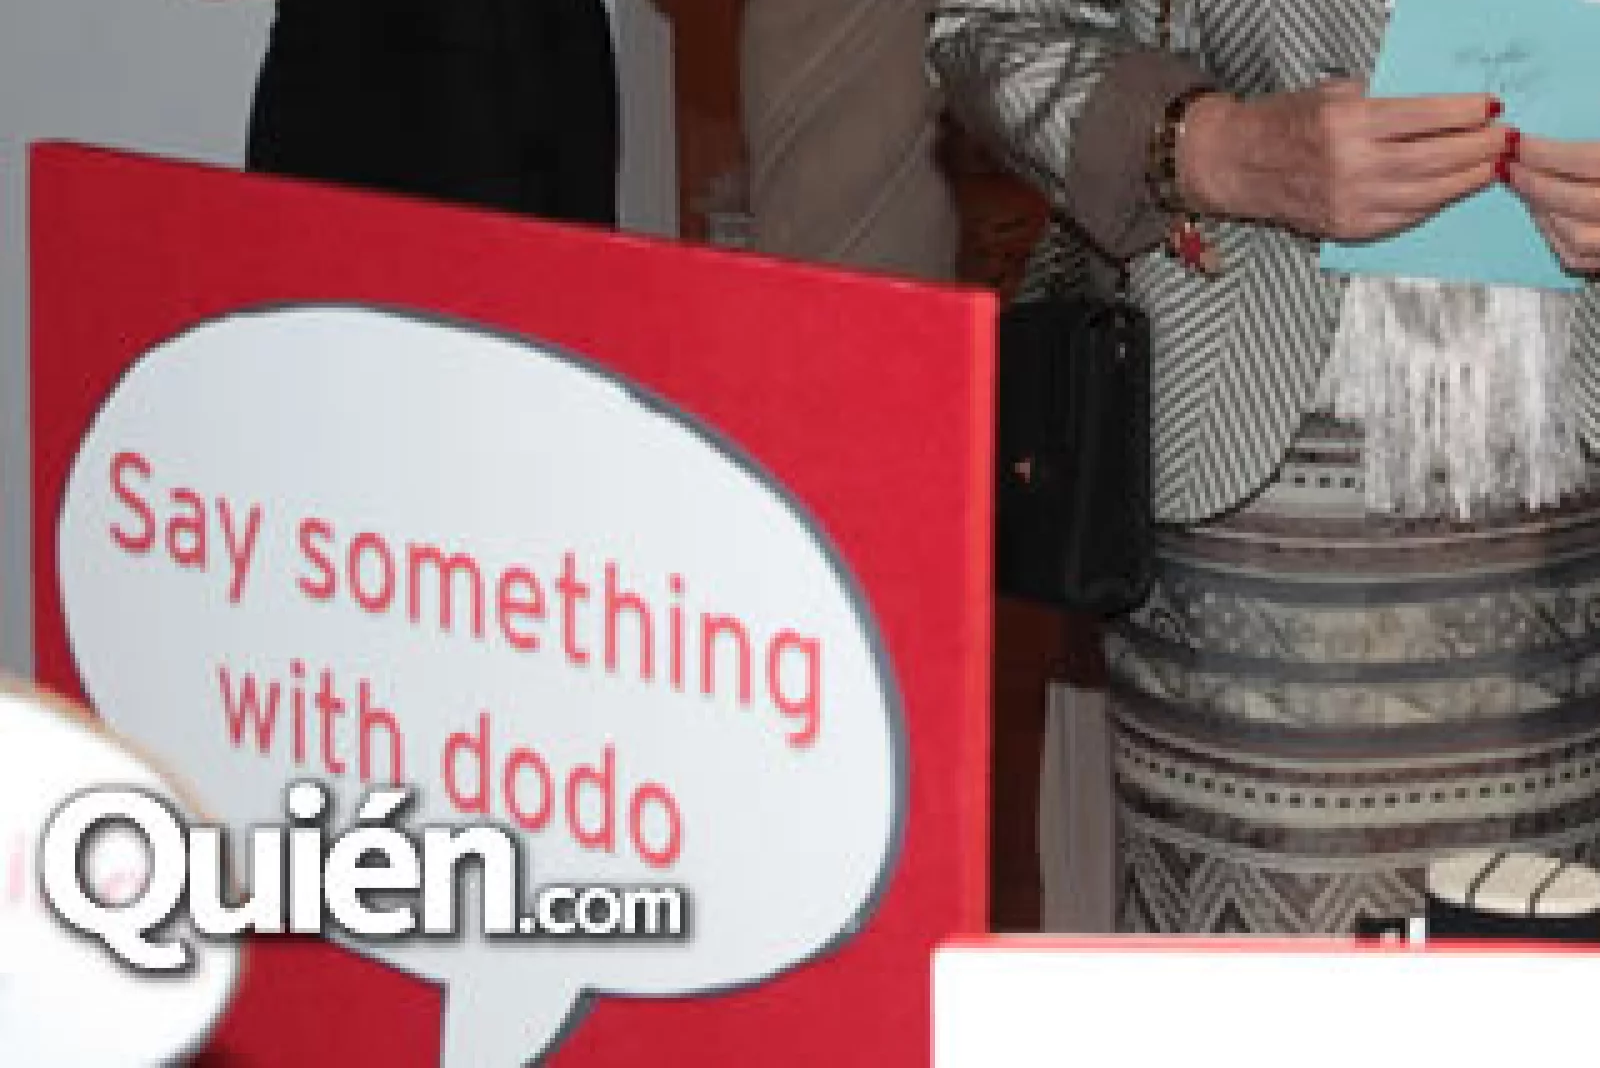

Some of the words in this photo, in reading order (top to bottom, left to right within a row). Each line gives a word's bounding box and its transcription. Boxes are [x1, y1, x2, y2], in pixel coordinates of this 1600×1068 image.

[107, 450, 263, 605] Say
[297, 516, 825, 750] something
[216, 657, 405, 785] with
[440, 708, 685, 870] dodo
